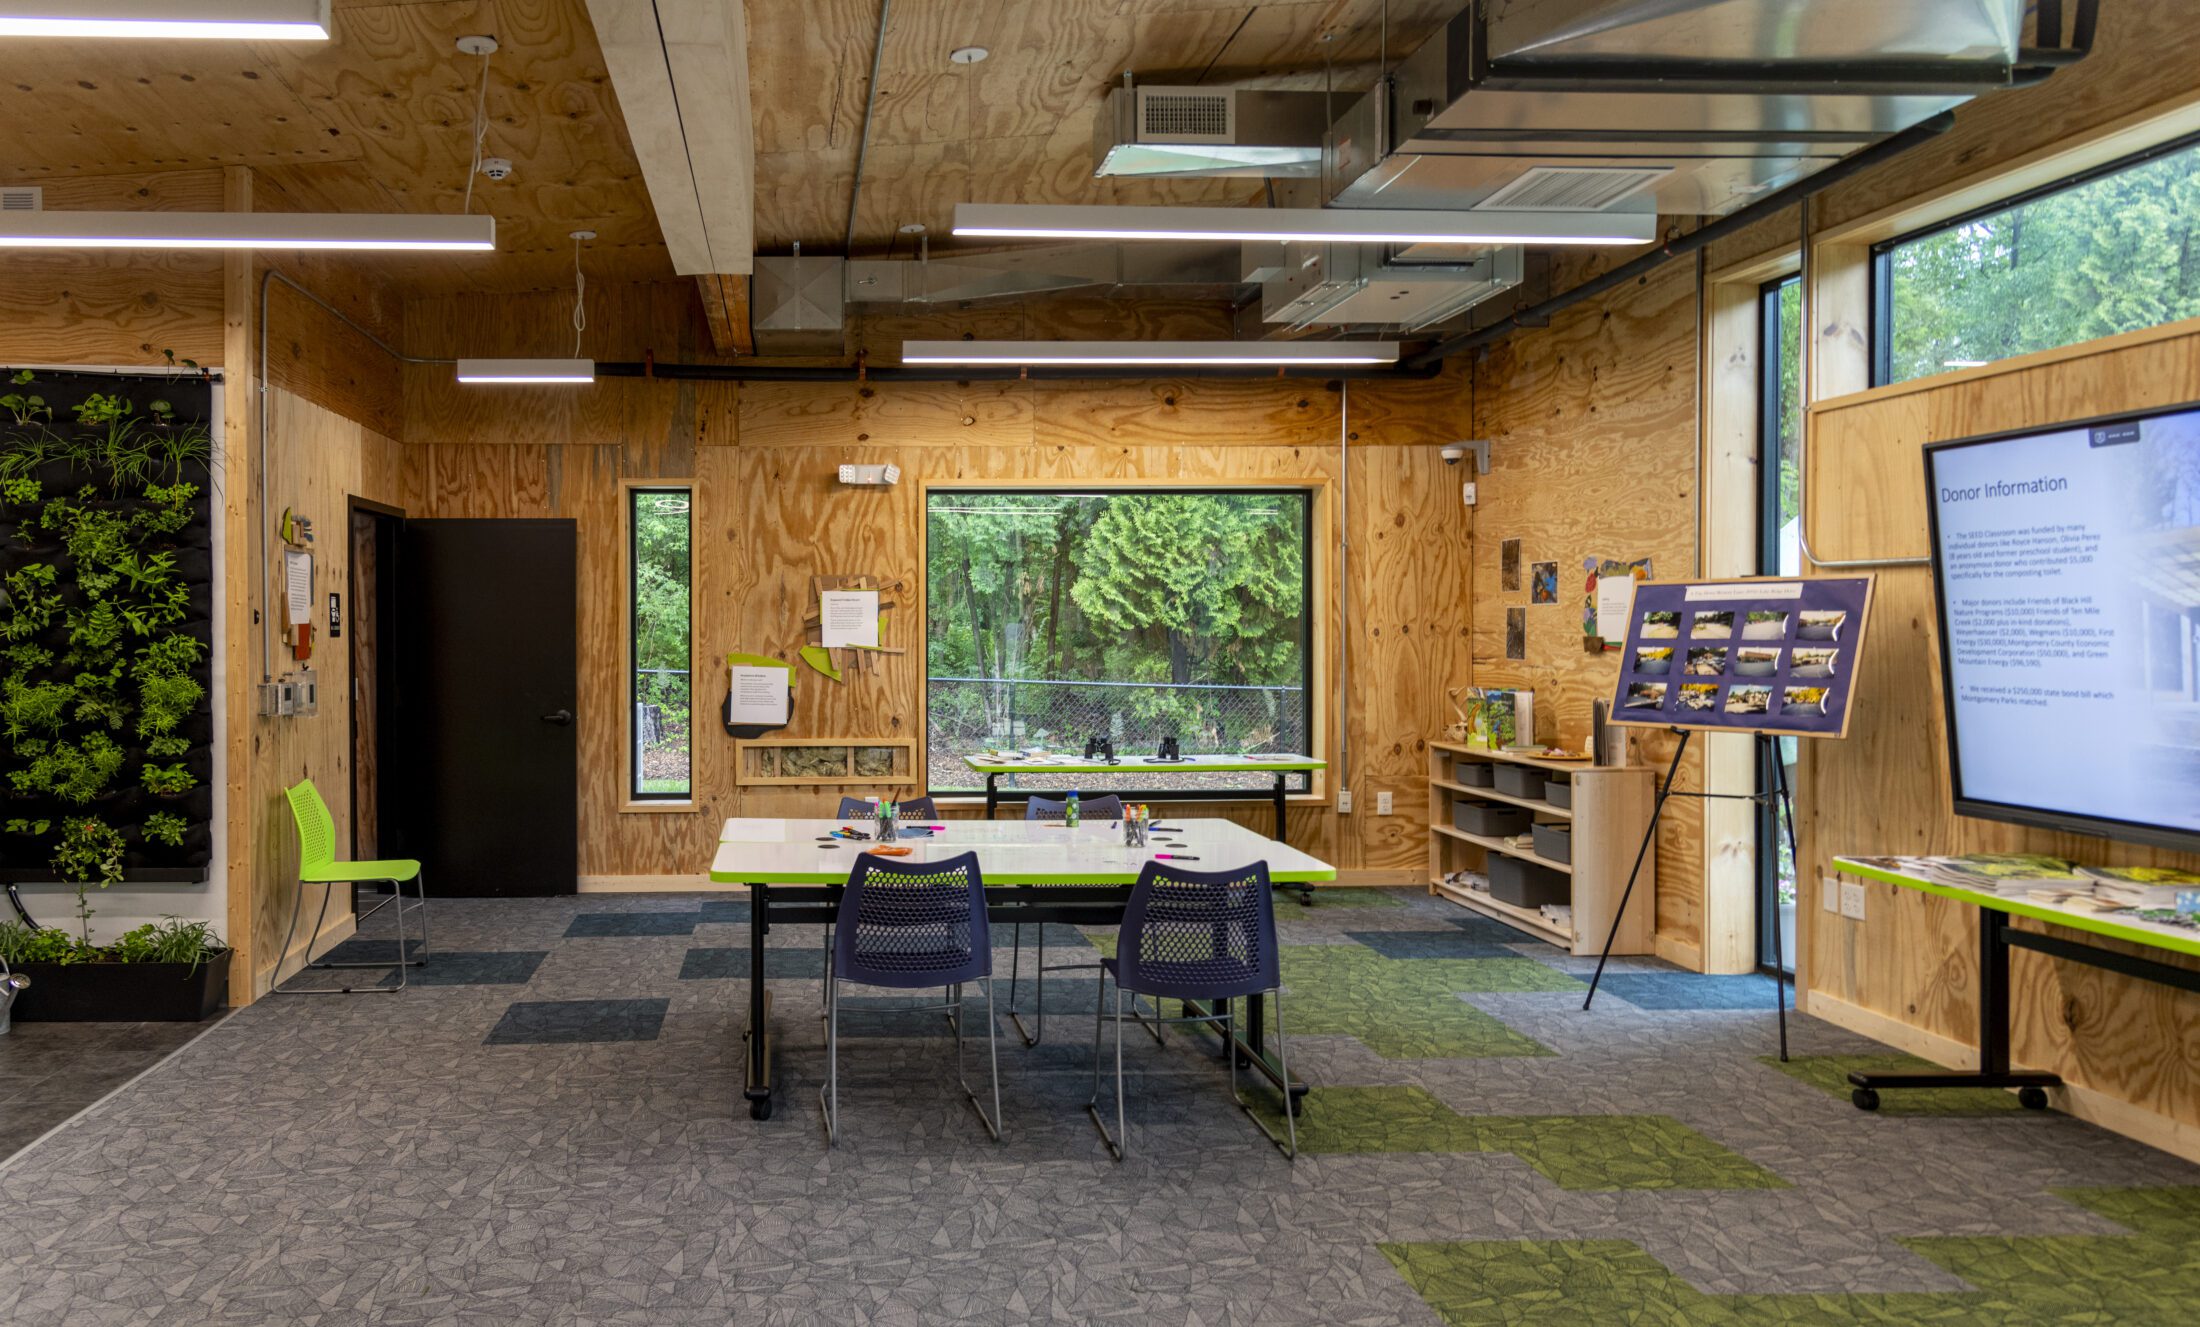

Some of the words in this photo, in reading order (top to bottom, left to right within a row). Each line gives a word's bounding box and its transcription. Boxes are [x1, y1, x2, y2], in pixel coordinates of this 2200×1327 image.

[1942, 486, 1981, 503] Donor
[1985, 476, 2068, 497] Information
[2032, 525, 2054, 534] funded
[1978, 540, 1998, 548] donors
[2019, 548, 2050, 556] preschool
[2029, 557, 2067, 565] contributed
[2069, 556, 2093, 564] $5,000
[2005, 568, 2042, 577] composting
[1957, 648, 1996, 657] Development
[1961, 695, 1999, 704] Montgomery
